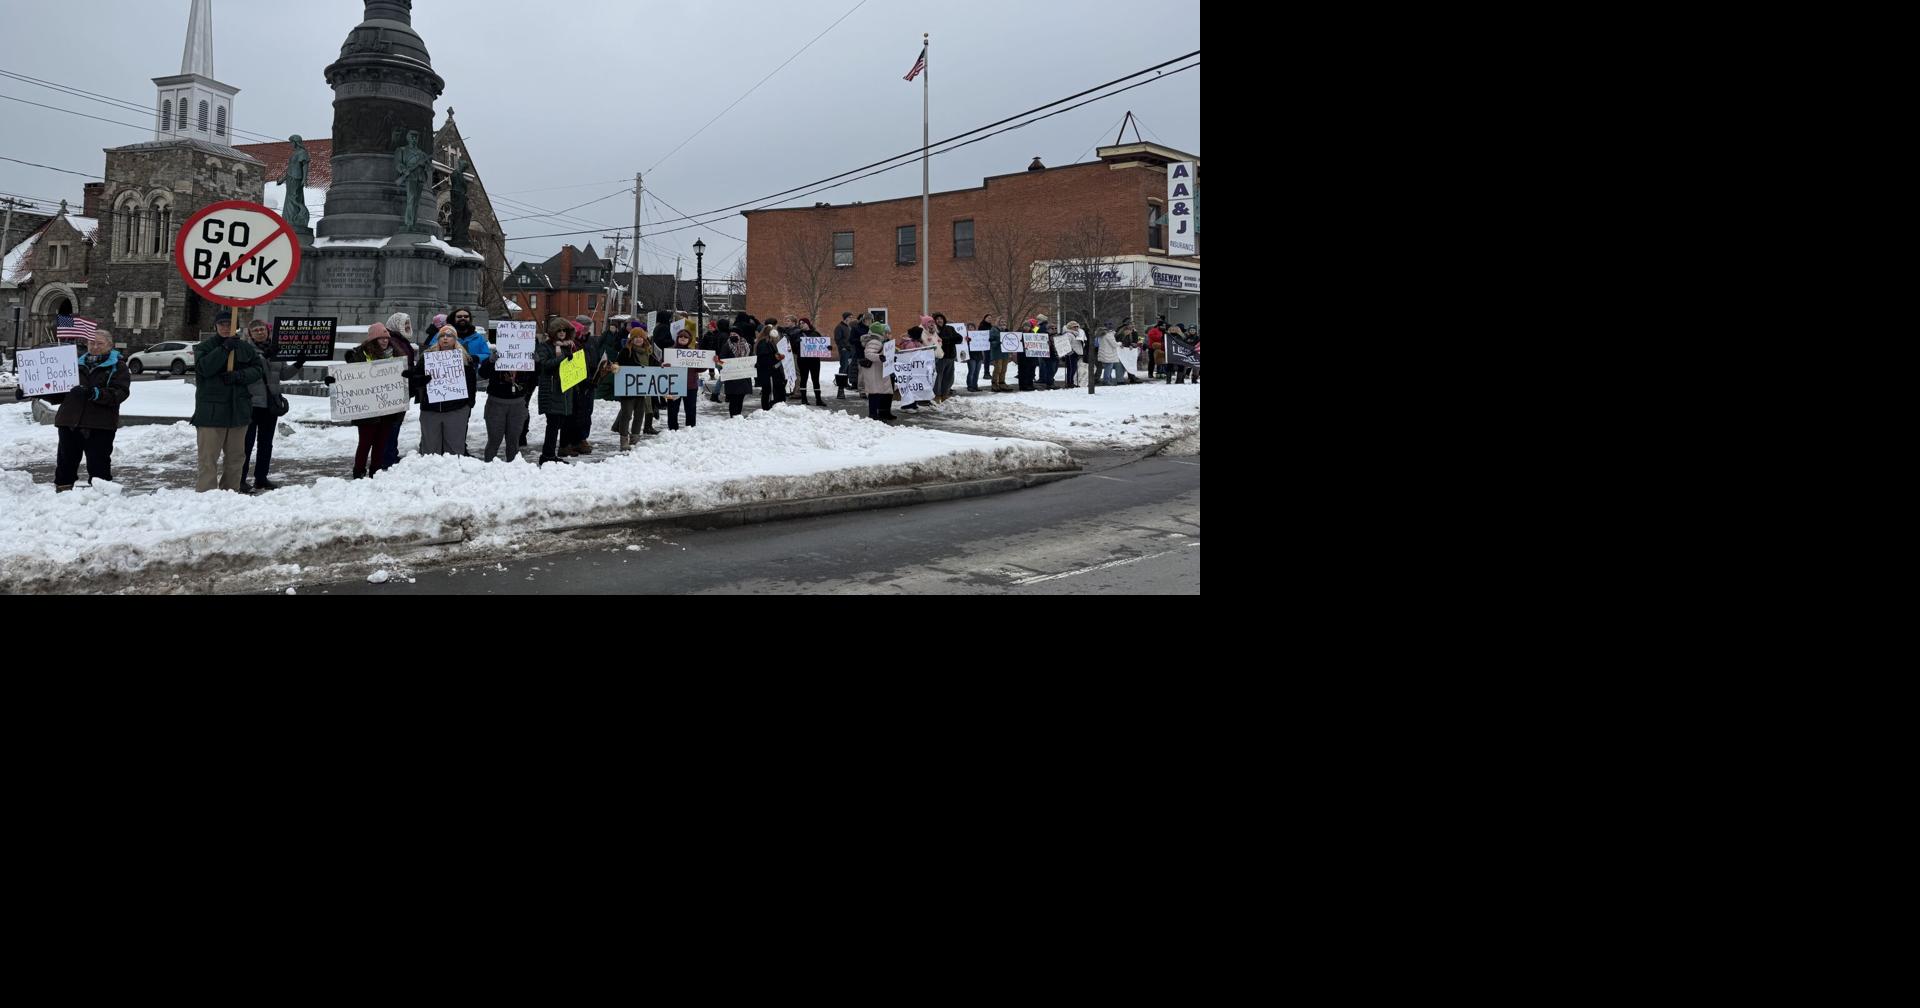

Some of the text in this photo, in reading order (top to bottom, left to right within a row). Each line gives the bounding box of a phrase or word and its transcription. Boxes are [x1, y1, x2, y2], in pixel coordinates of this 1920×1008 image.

[202, 218, 250, 247] GO
[1169, 240, 1194, 252] INSURANCE
[193, 247, 278, 287] BACK
[1153, 271, 1182, 282] FREEWAY
[17, 351, 58, 368] Ban Bras
[432, 351, 452, 361] NEED
[676, 349, 706, 359] PEOPLE
[24, 361, 77, 382] Not Books!
[21, 383, 44, 395] Love
[443, 385, 466, 396] SILENT
[625, 374, 679, 396] PEACE
[336, 397, 352, 407] NO
[375, 393, 389, 402] NO
[339, 404, 370, 415] UTERUS
